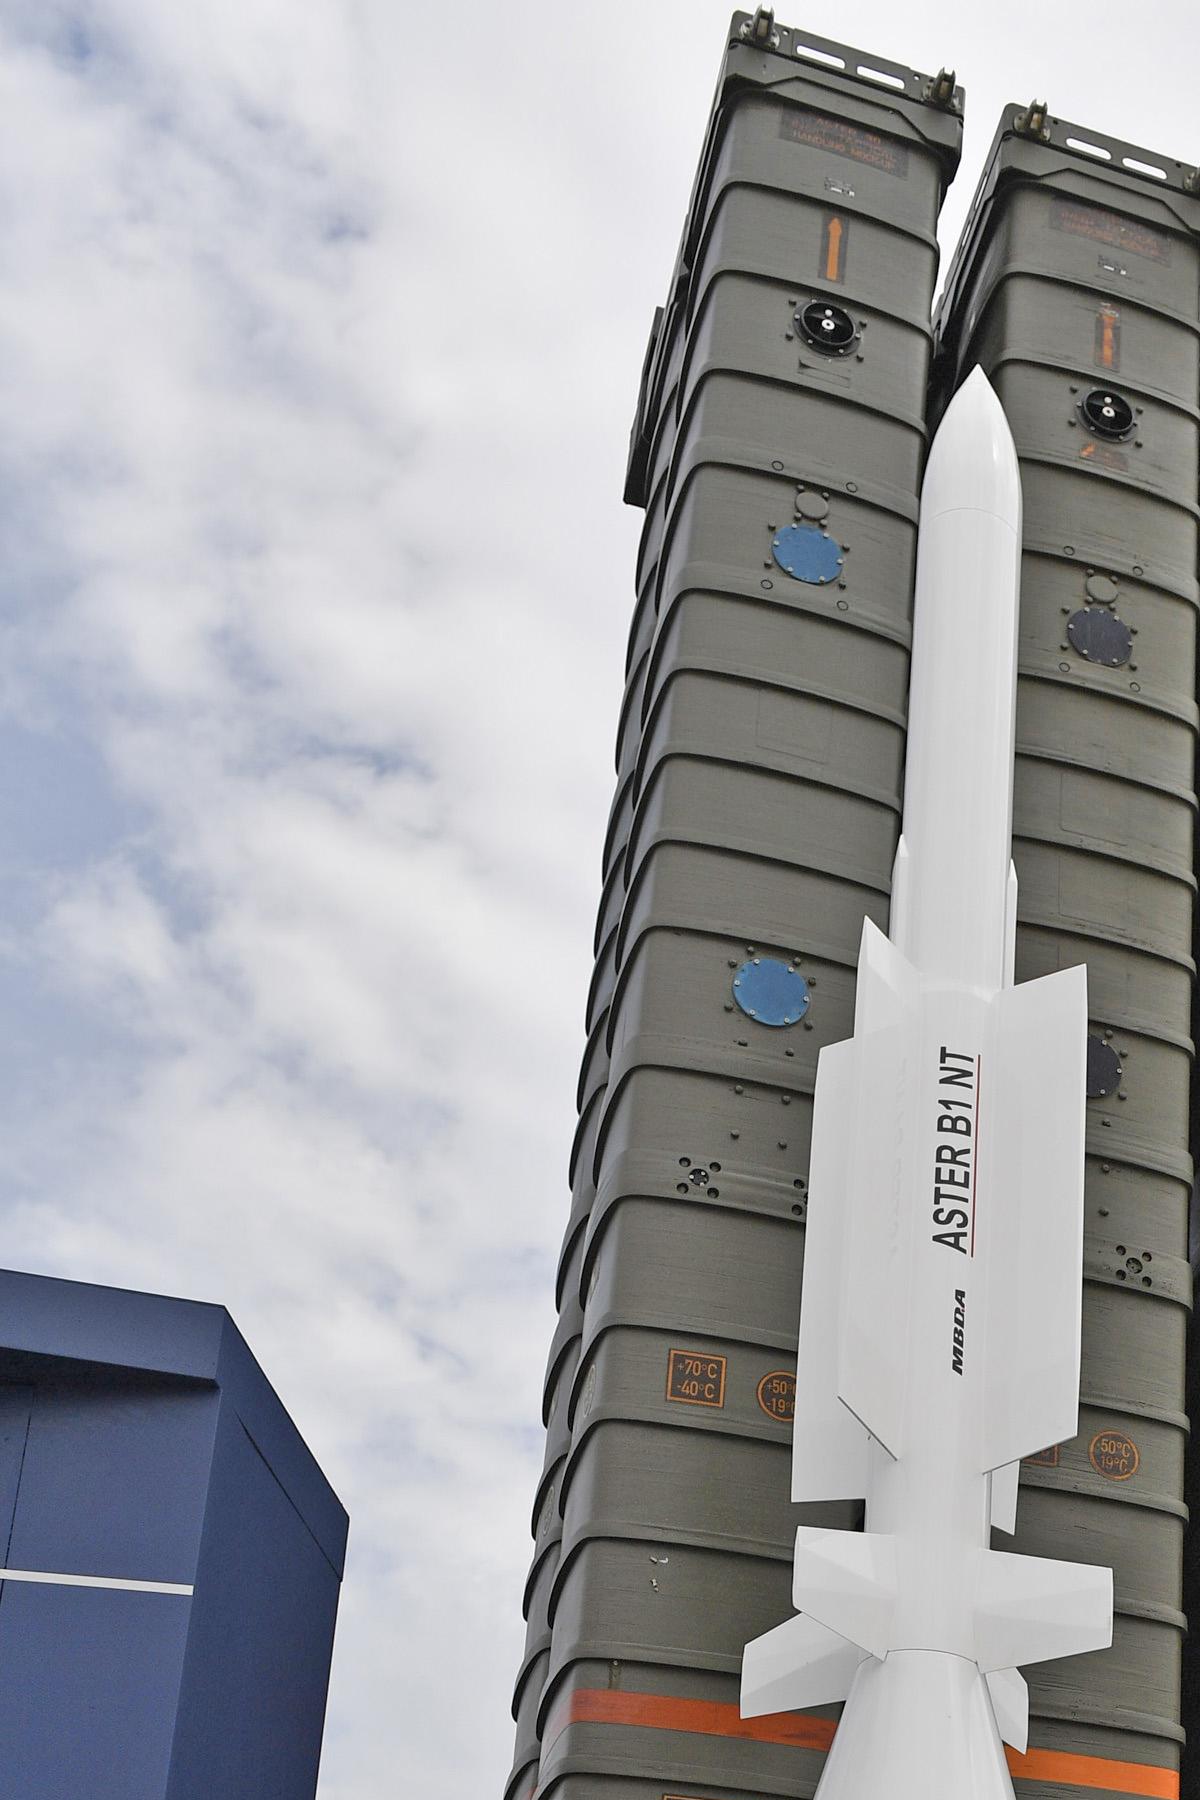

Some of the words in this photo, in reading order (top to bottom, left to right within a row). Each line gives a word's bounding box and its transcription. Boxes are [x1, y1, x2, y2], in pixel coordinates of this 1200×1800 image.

[939, 1046, 974, 1089] NT
[937, 1099, 972, 1137] B1
[932, 1144, 971, 1254] ASTER
[952, 1289, 966, 1375] MBDA
